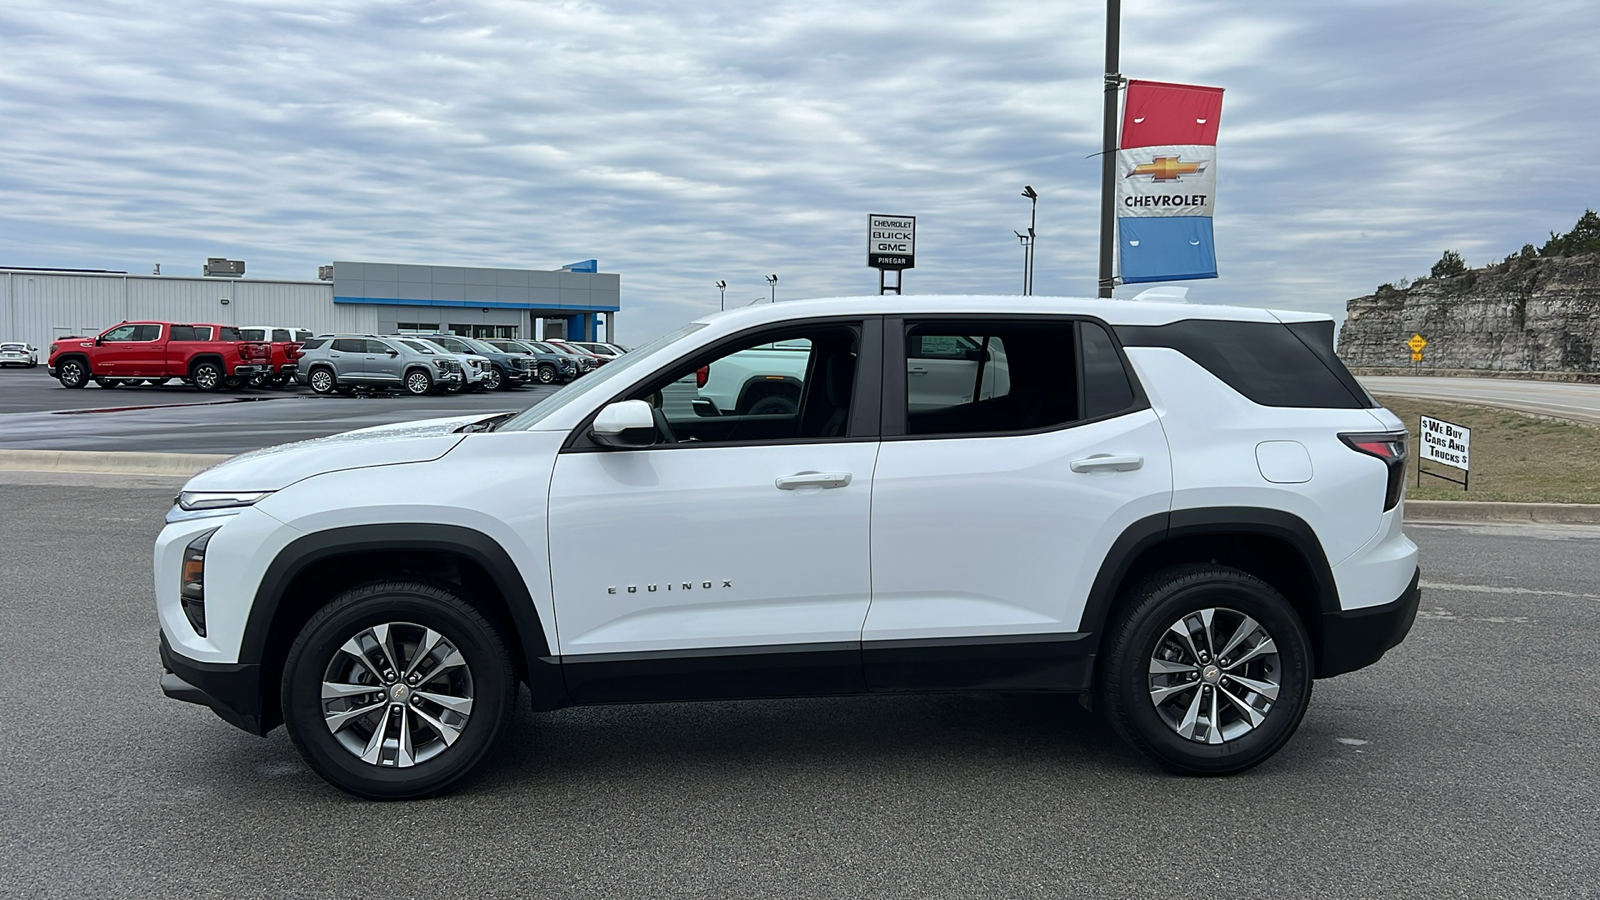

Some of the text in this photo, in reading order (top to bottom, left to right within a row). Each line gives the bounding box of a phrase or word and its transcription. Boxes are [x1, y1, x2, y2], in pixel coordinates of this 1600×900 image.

[1125, 195, 1207, 207] CHEVROLET
[874, 220, 912, 228] CHEVROLET
[873, 231, 912, 240] BUICK
[878, 243, 907, 252] GMC
[877, 257, 906, 265] PINEGAR
[607, 579, 732, 595] EQUINOX
